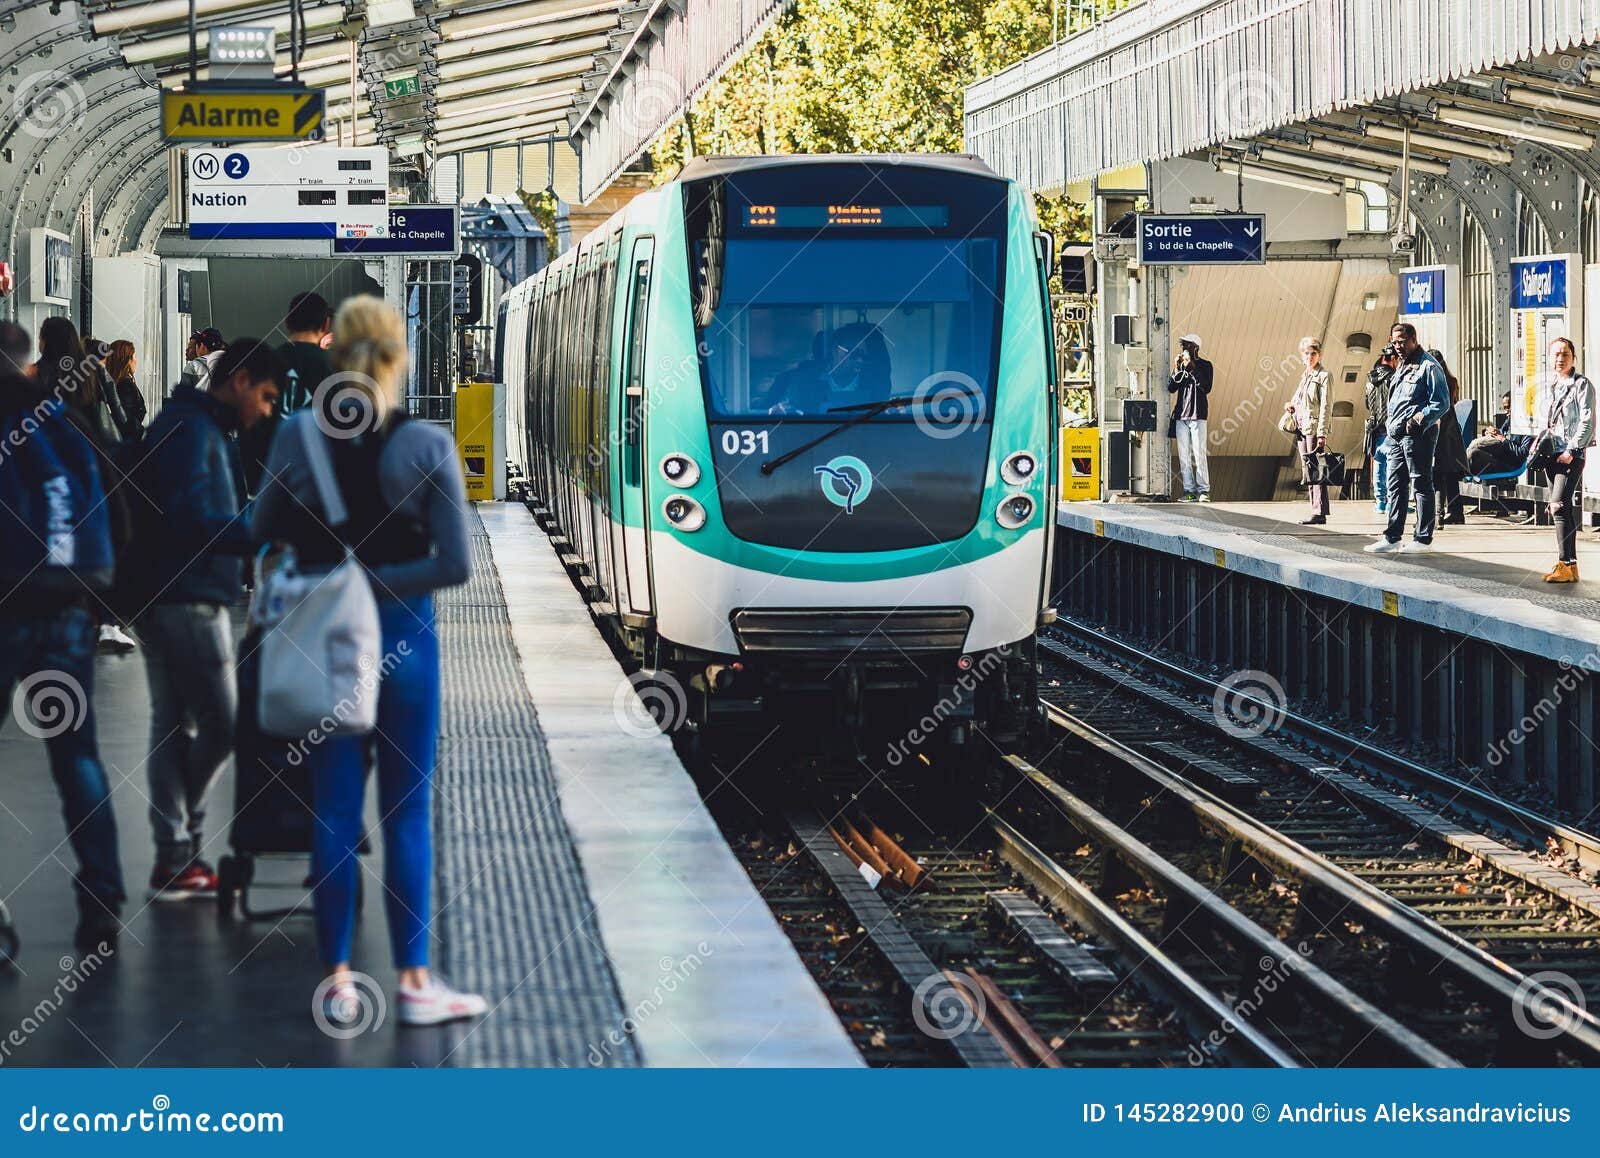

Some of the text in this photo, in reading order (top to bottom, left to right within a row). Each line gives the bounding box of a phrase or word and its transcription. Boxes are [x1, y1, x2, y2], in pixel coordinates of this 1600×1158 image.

[178, 102, 280, 128] Alarme
[192, 192, 247, 206] Nation
[371, 197, 385, 205] min
[398, 230, 406, 238] la
[408, 230, 445, 240] Chapelle
[1144, 223, 1192, 237] Sortie
[1147, 241, 1233, 252] 3 bd de la Chapelle
[1522, 265, 1553, 304] Stalingrad
[1407, 275, 1432, 310] Stalingrad
[1065, 307, 1086, 321] 50
[721, 430, 769, 455] 031
